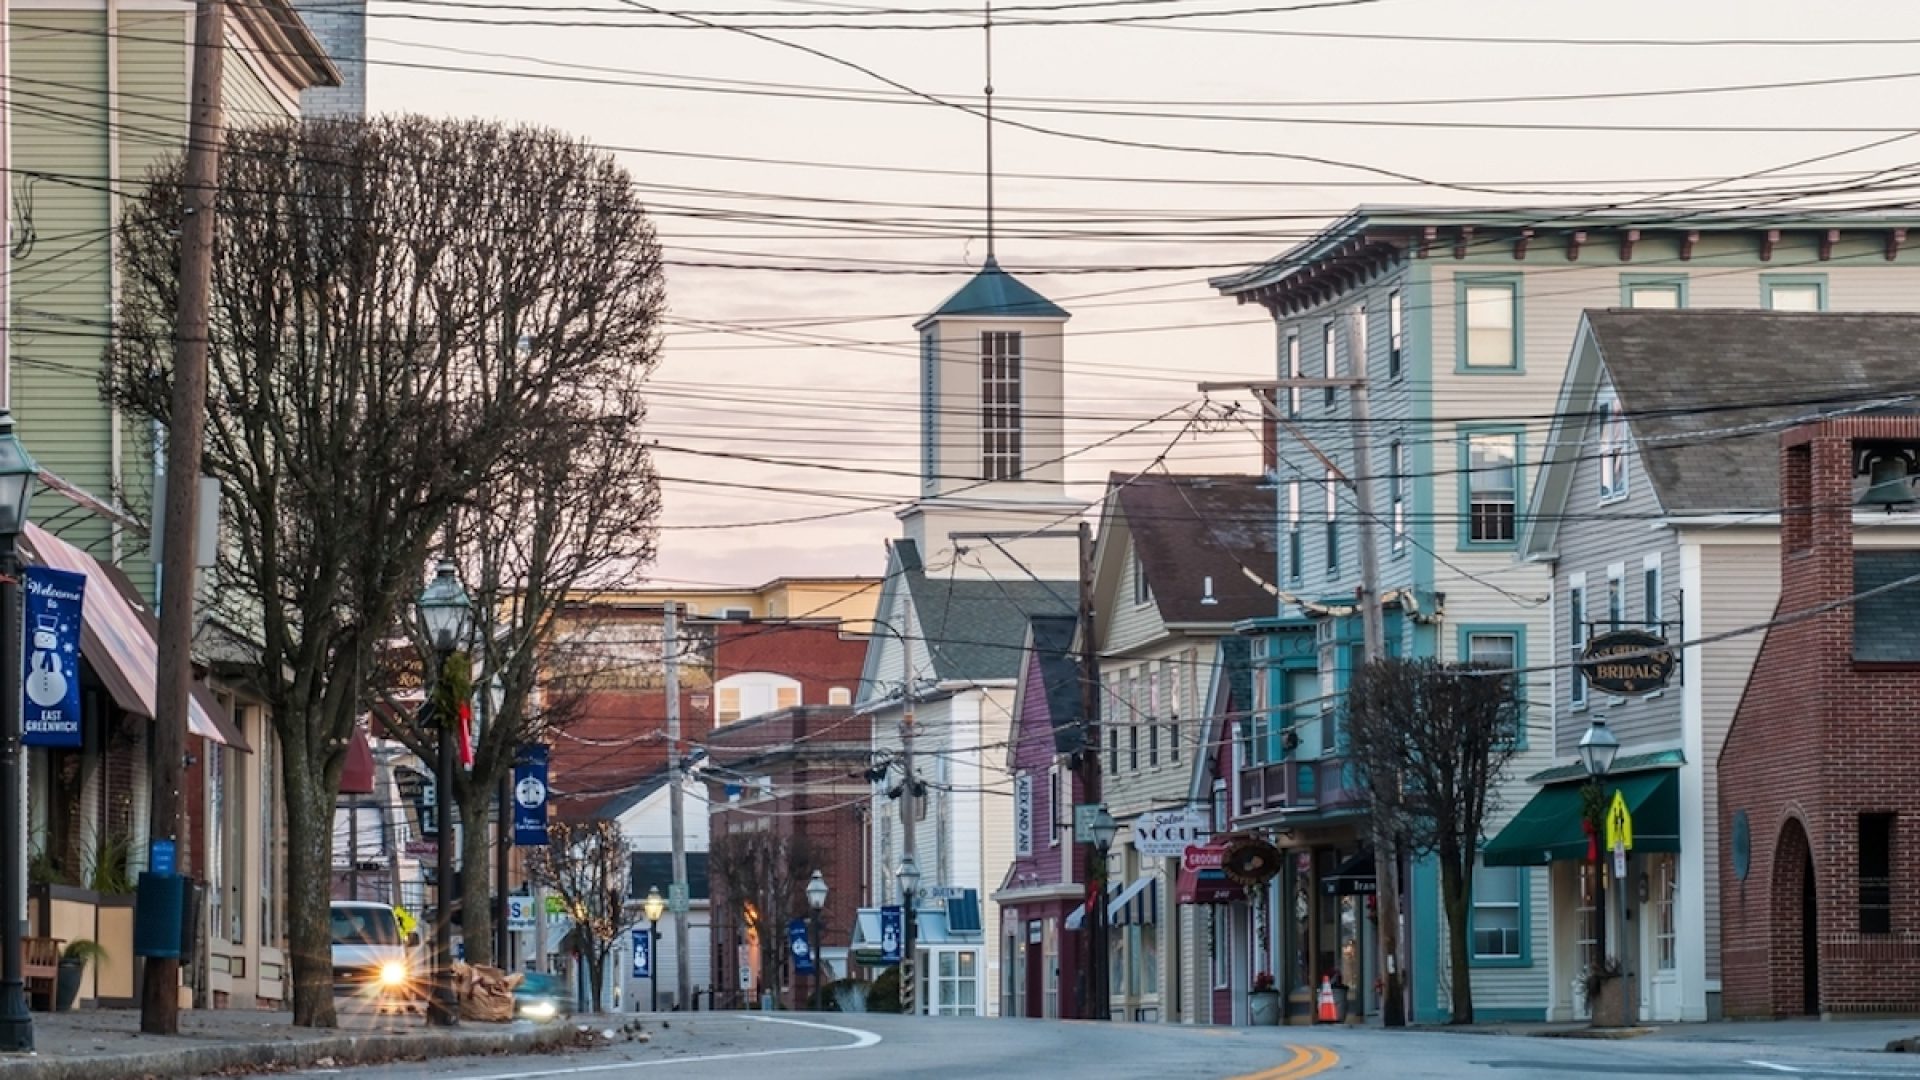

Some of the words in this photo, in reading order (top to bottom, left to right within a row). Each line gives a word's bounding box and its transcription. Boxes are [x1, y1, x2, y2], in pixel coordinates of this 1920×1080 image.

[28, 581, 80, 600] Welcome
[1596, 664, 1661, 679] BRIDALS
[41, 709, 62, 720] EAST
[26, 720, 77, 732] GREENWICH
[1018, 807, 1029, 831] AND
